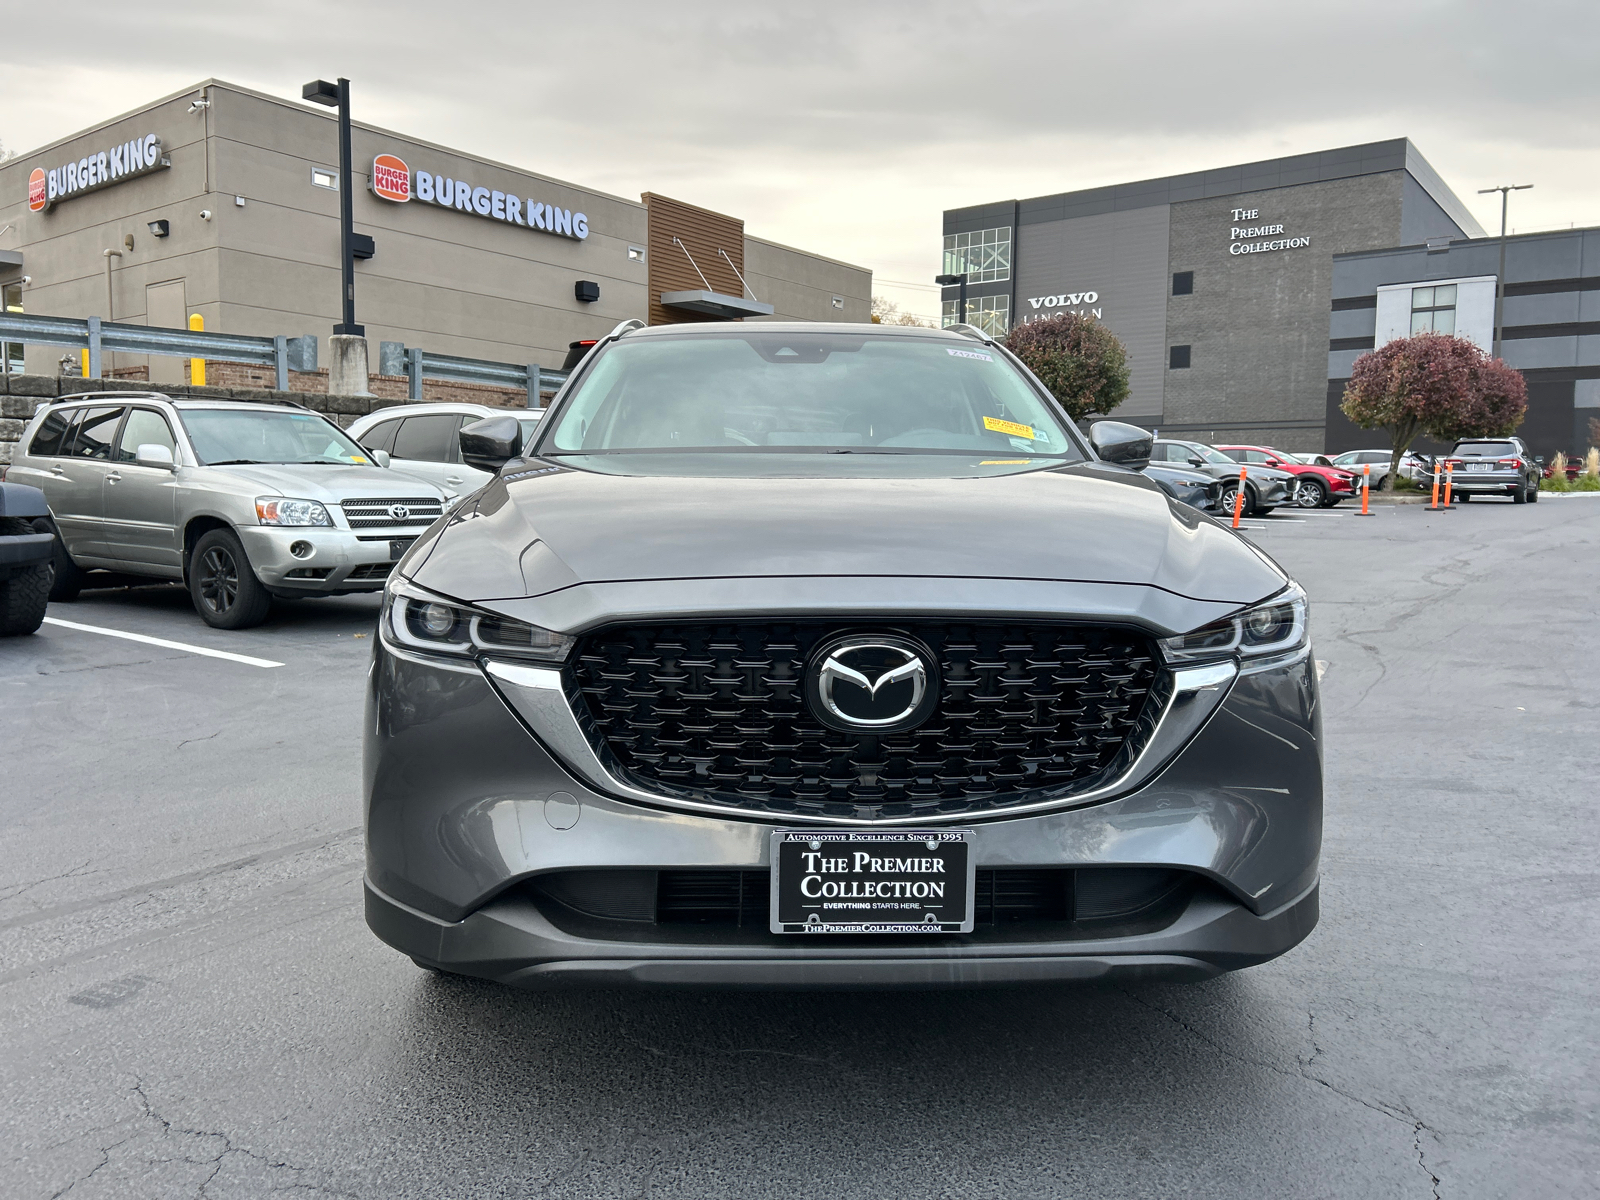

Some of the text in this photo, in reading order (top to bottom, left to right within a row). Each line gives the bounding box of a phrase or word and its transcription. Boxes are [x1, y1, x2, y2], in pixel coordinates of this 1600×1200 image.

[48, 133, 158, 199] BURGER KING
[375, 165, 409, 183] BURGER
[375, 175, 409, 194] KING
[416, 170, 590, 240] BURGER KING
[1231, 207, 1260, 222] THE
[1230, 223, 1285, 241] PREMIER
[1229, 236, 1311, 256] COLLECTION
[1027, 291, 1099, 309] VOLVO
[786, 833, 962, 841] AUTOMOTIVE EXCELLENCE SINCE 1995
[801, 851, 946, 873] THE PREMIER
[800, 875, 946, 898] COLLECTION
[900, 902, 922, 910] HERE.
